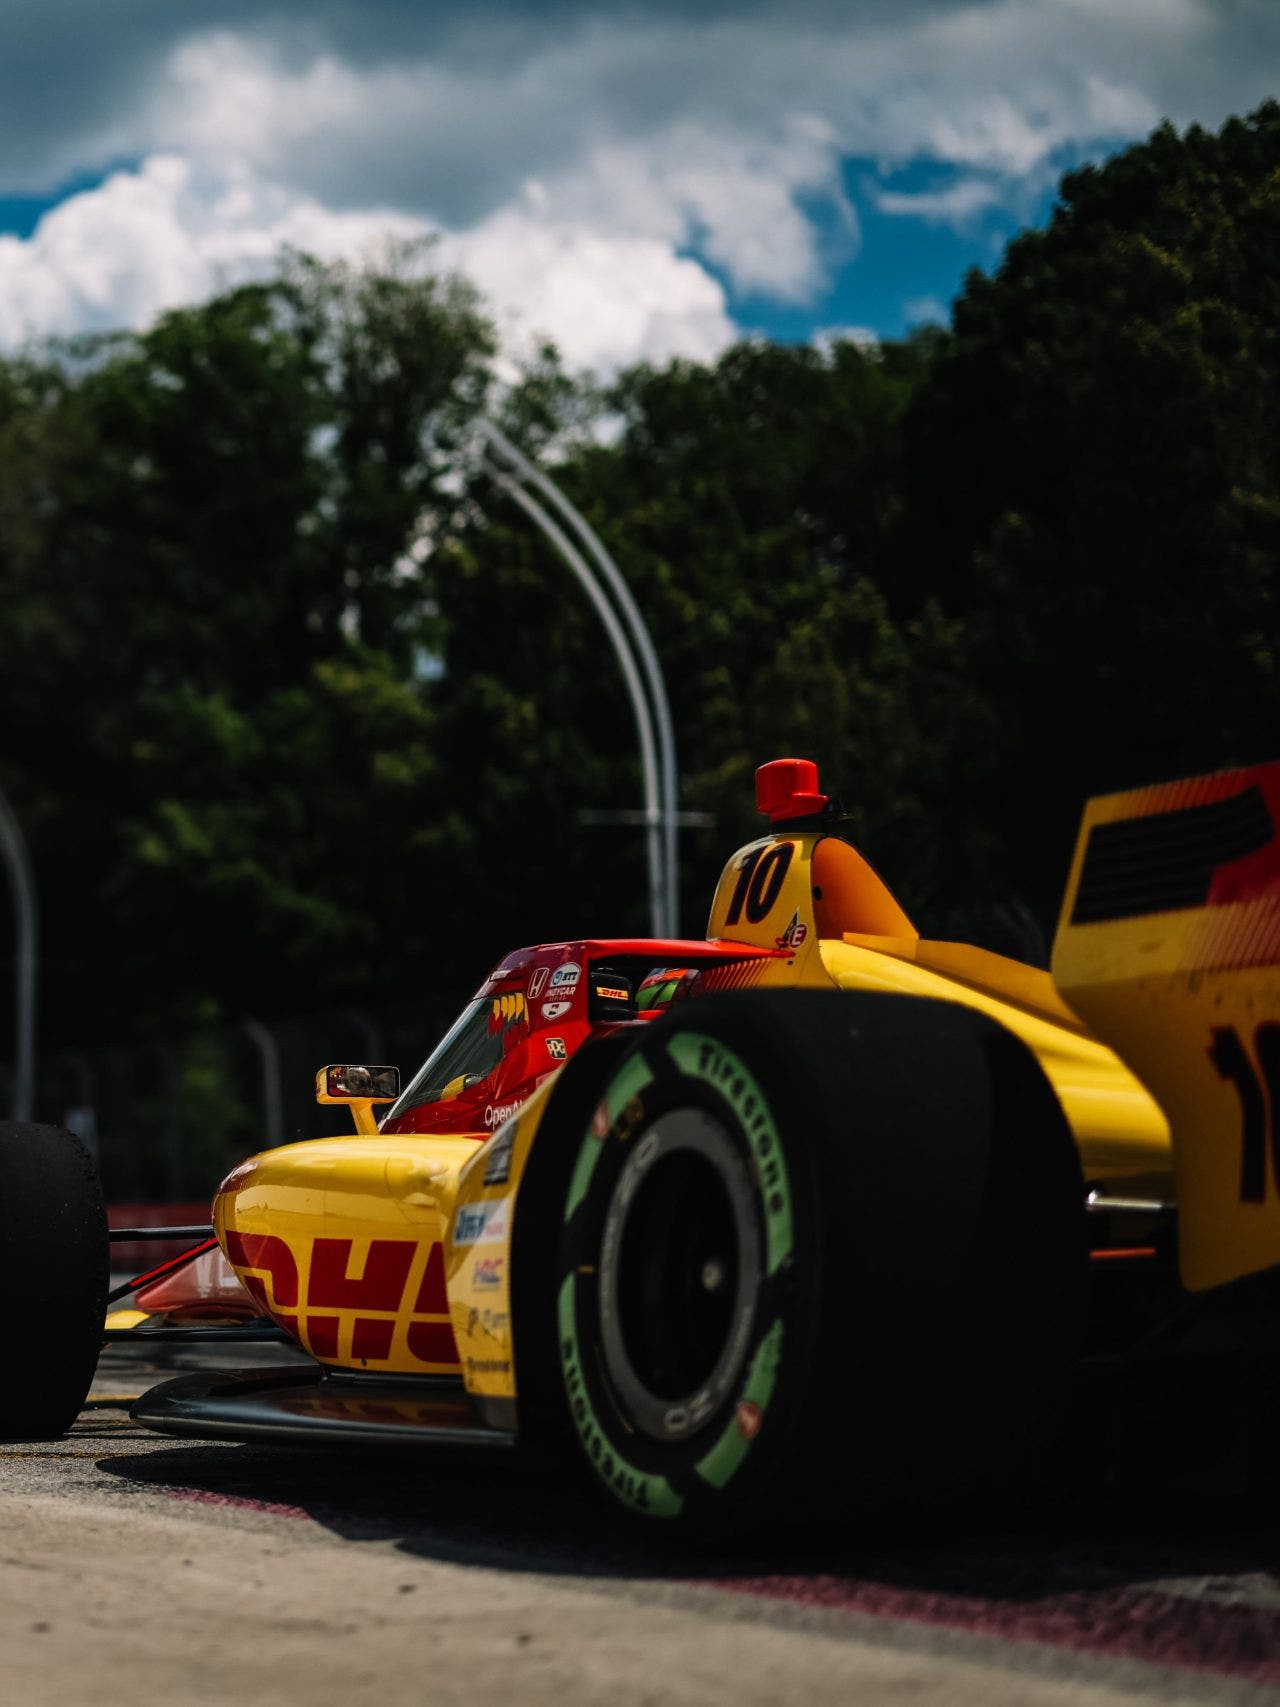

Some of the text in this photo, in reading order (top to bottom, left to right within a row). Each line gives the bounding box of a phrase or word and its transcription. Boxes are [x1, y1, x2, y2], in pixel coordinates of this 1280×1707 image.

[724, 842, 795, 927] 10
[602, 989, 625, 998] DHL
[547, 1040, 566, 1058] PPG
[698, 1042, 784, 1214] Firestone
